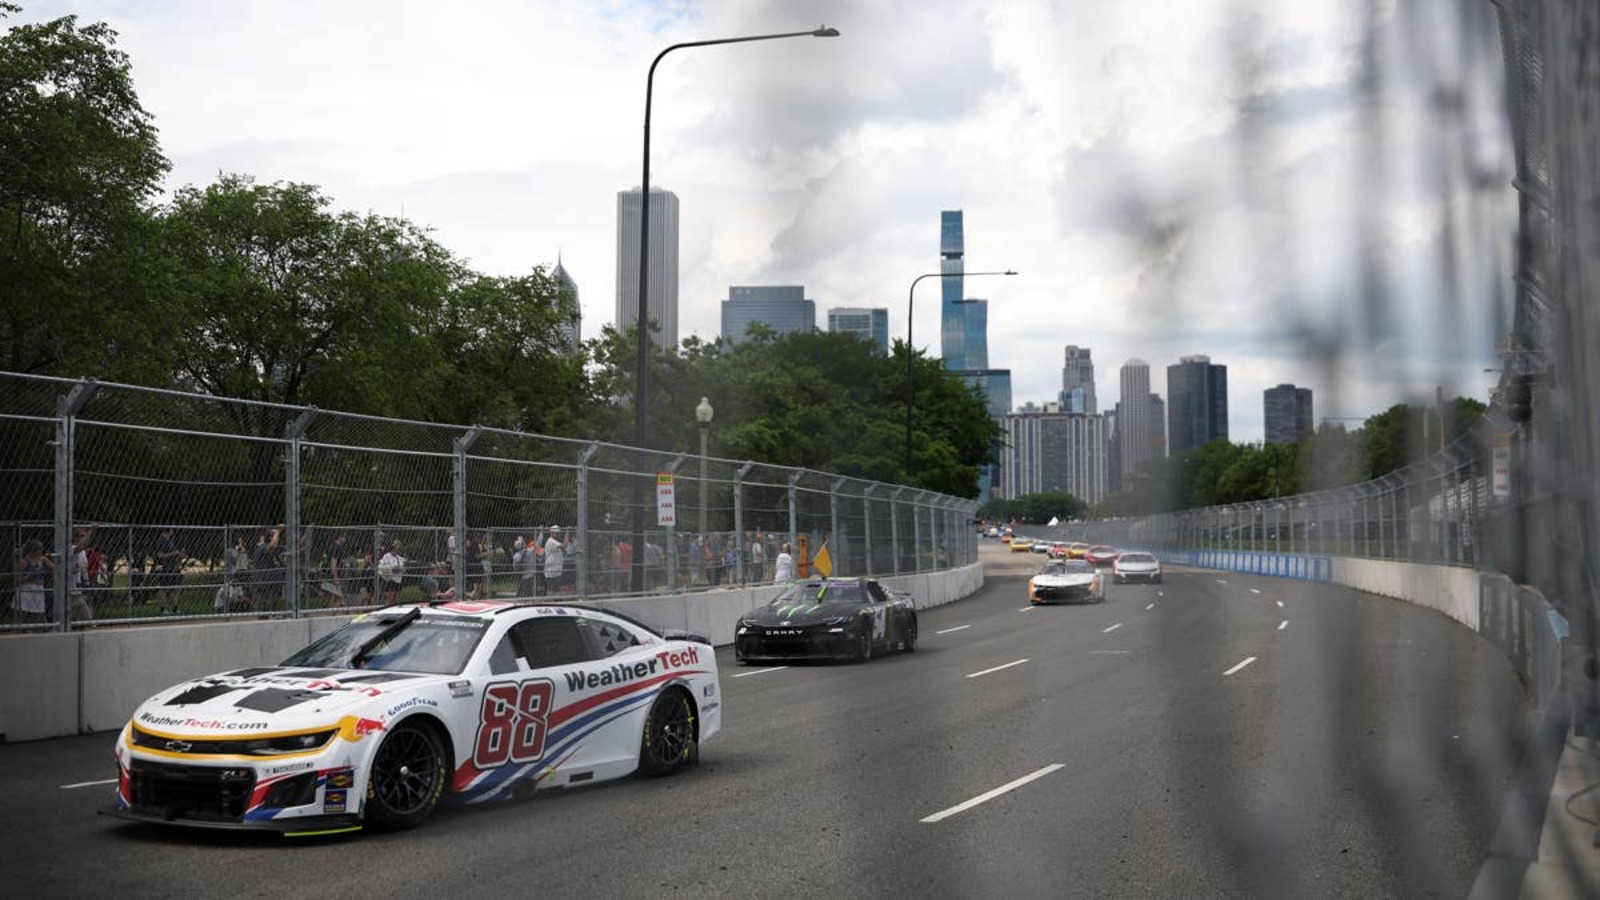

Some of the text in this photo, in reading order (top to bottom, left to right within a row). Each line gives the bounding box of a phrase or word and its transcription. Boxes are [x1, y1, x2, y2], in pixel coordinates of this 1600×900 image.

[564, 647, 699, 692] WeatherTech
[139, 712, 268, 730] WeatherTech.com
[388, 697, 438, 716] GOODYEAR
[472, 677, 555, 769] 88
